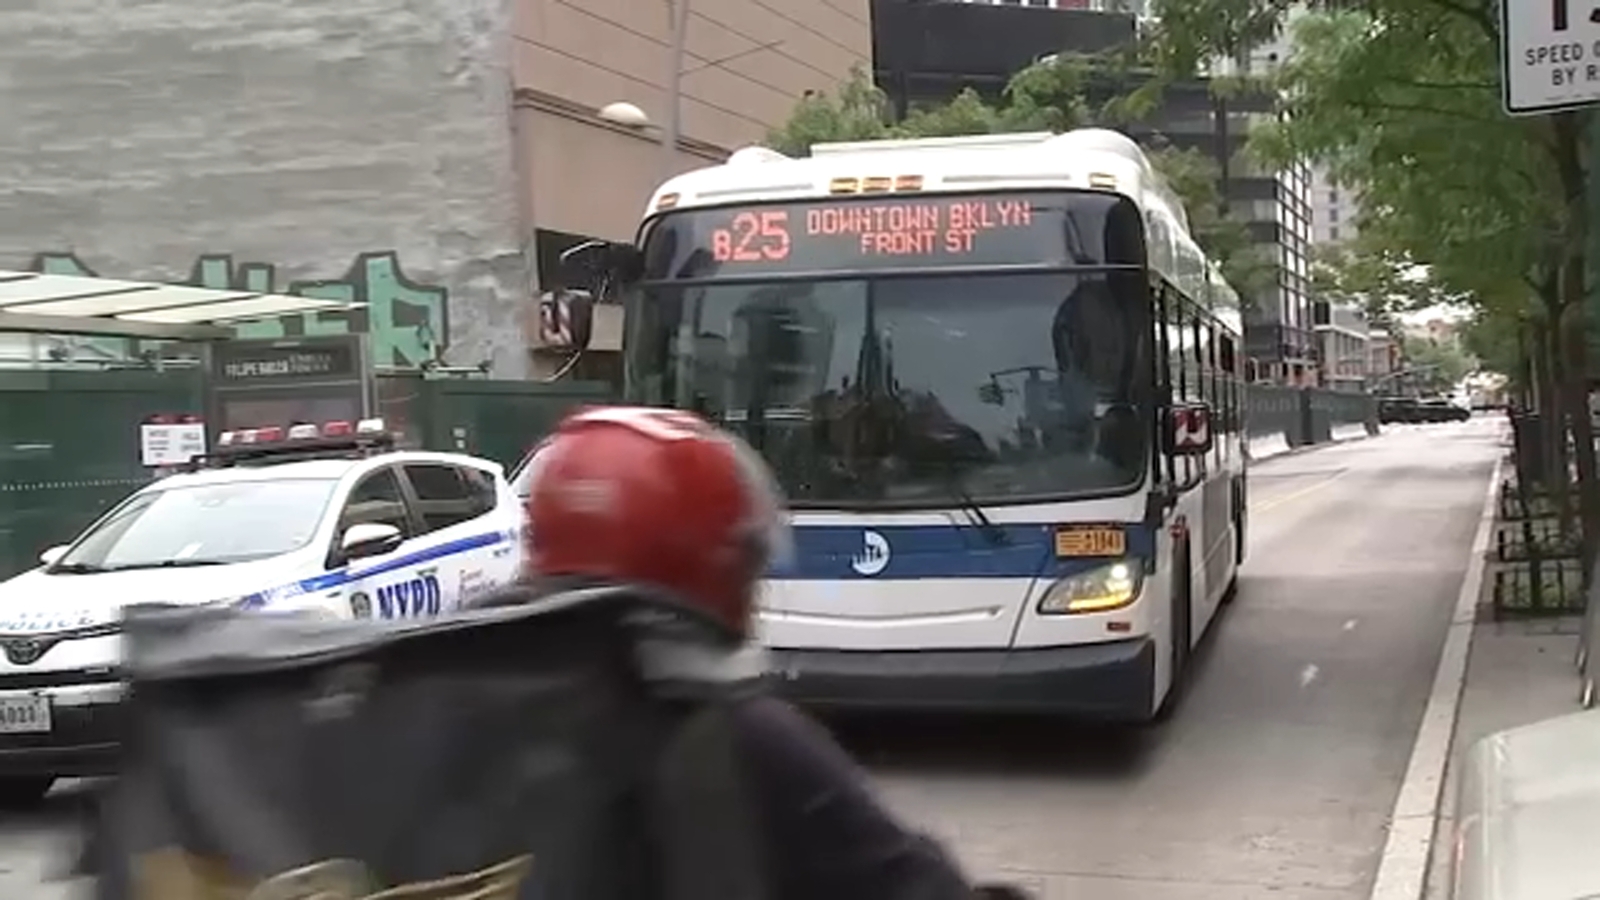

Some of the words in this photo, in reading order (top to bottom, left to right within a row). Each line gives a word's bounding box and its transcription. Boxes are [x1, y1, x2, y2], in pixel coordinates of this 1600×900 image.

[1525, 42, 1583, 66] SPEED
[1552, 67, 1576, 86] BY
[806, 206, 939, 234] DOWNTOWN
[950, 201, 1031, 228] BKLYN
[712, 210, 790, 261] B25
[860, 231, 936, 254] FRONT
[945, 229, 977, 252] ST
[376, 574, 441, 619] NYPD
